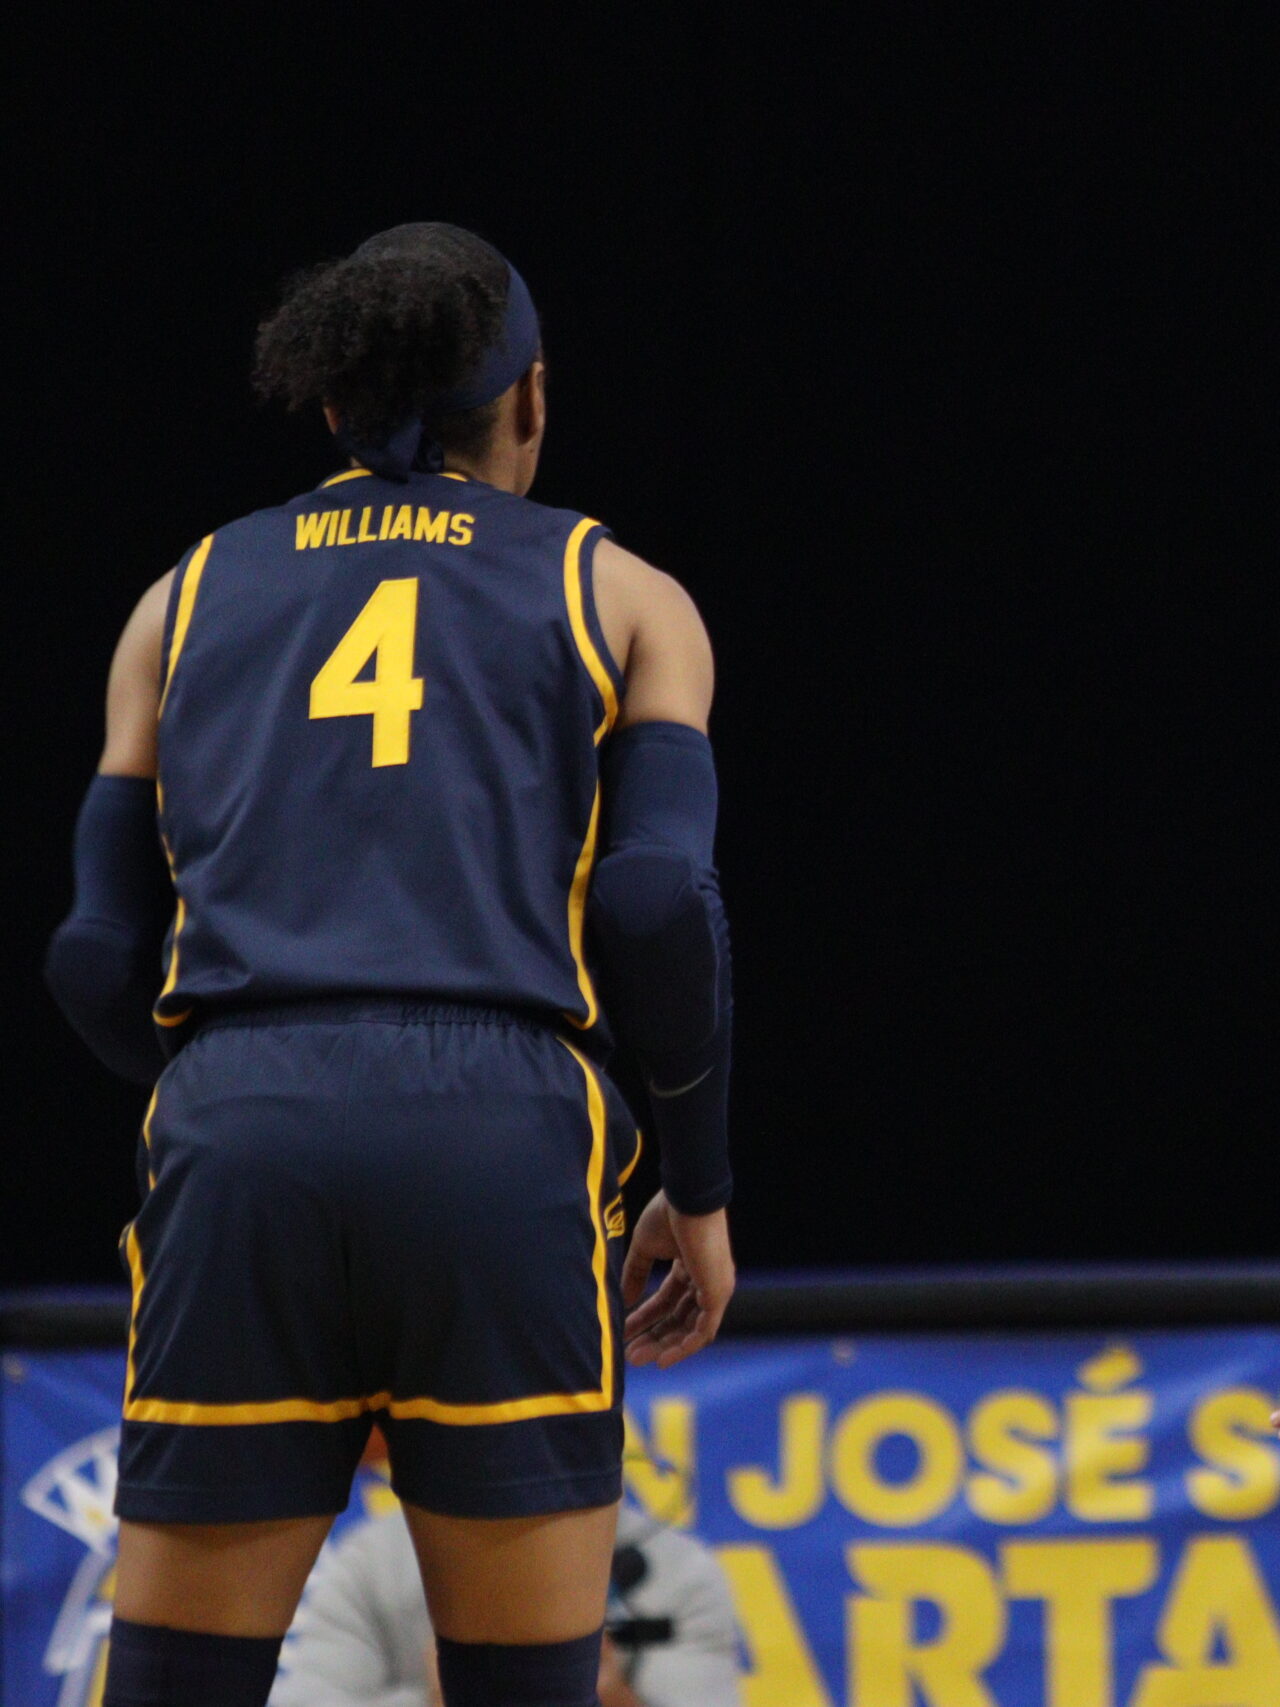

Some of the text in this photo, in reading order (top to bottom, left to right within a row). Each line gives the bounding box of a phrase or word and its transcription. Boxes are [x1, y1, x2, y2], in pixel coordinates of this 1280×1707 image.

[295, 505, 475, 550] WILLIAMS
[308, 577, 424, 768] 4
[726, 1346, 1156, 1530] JOSÉ
